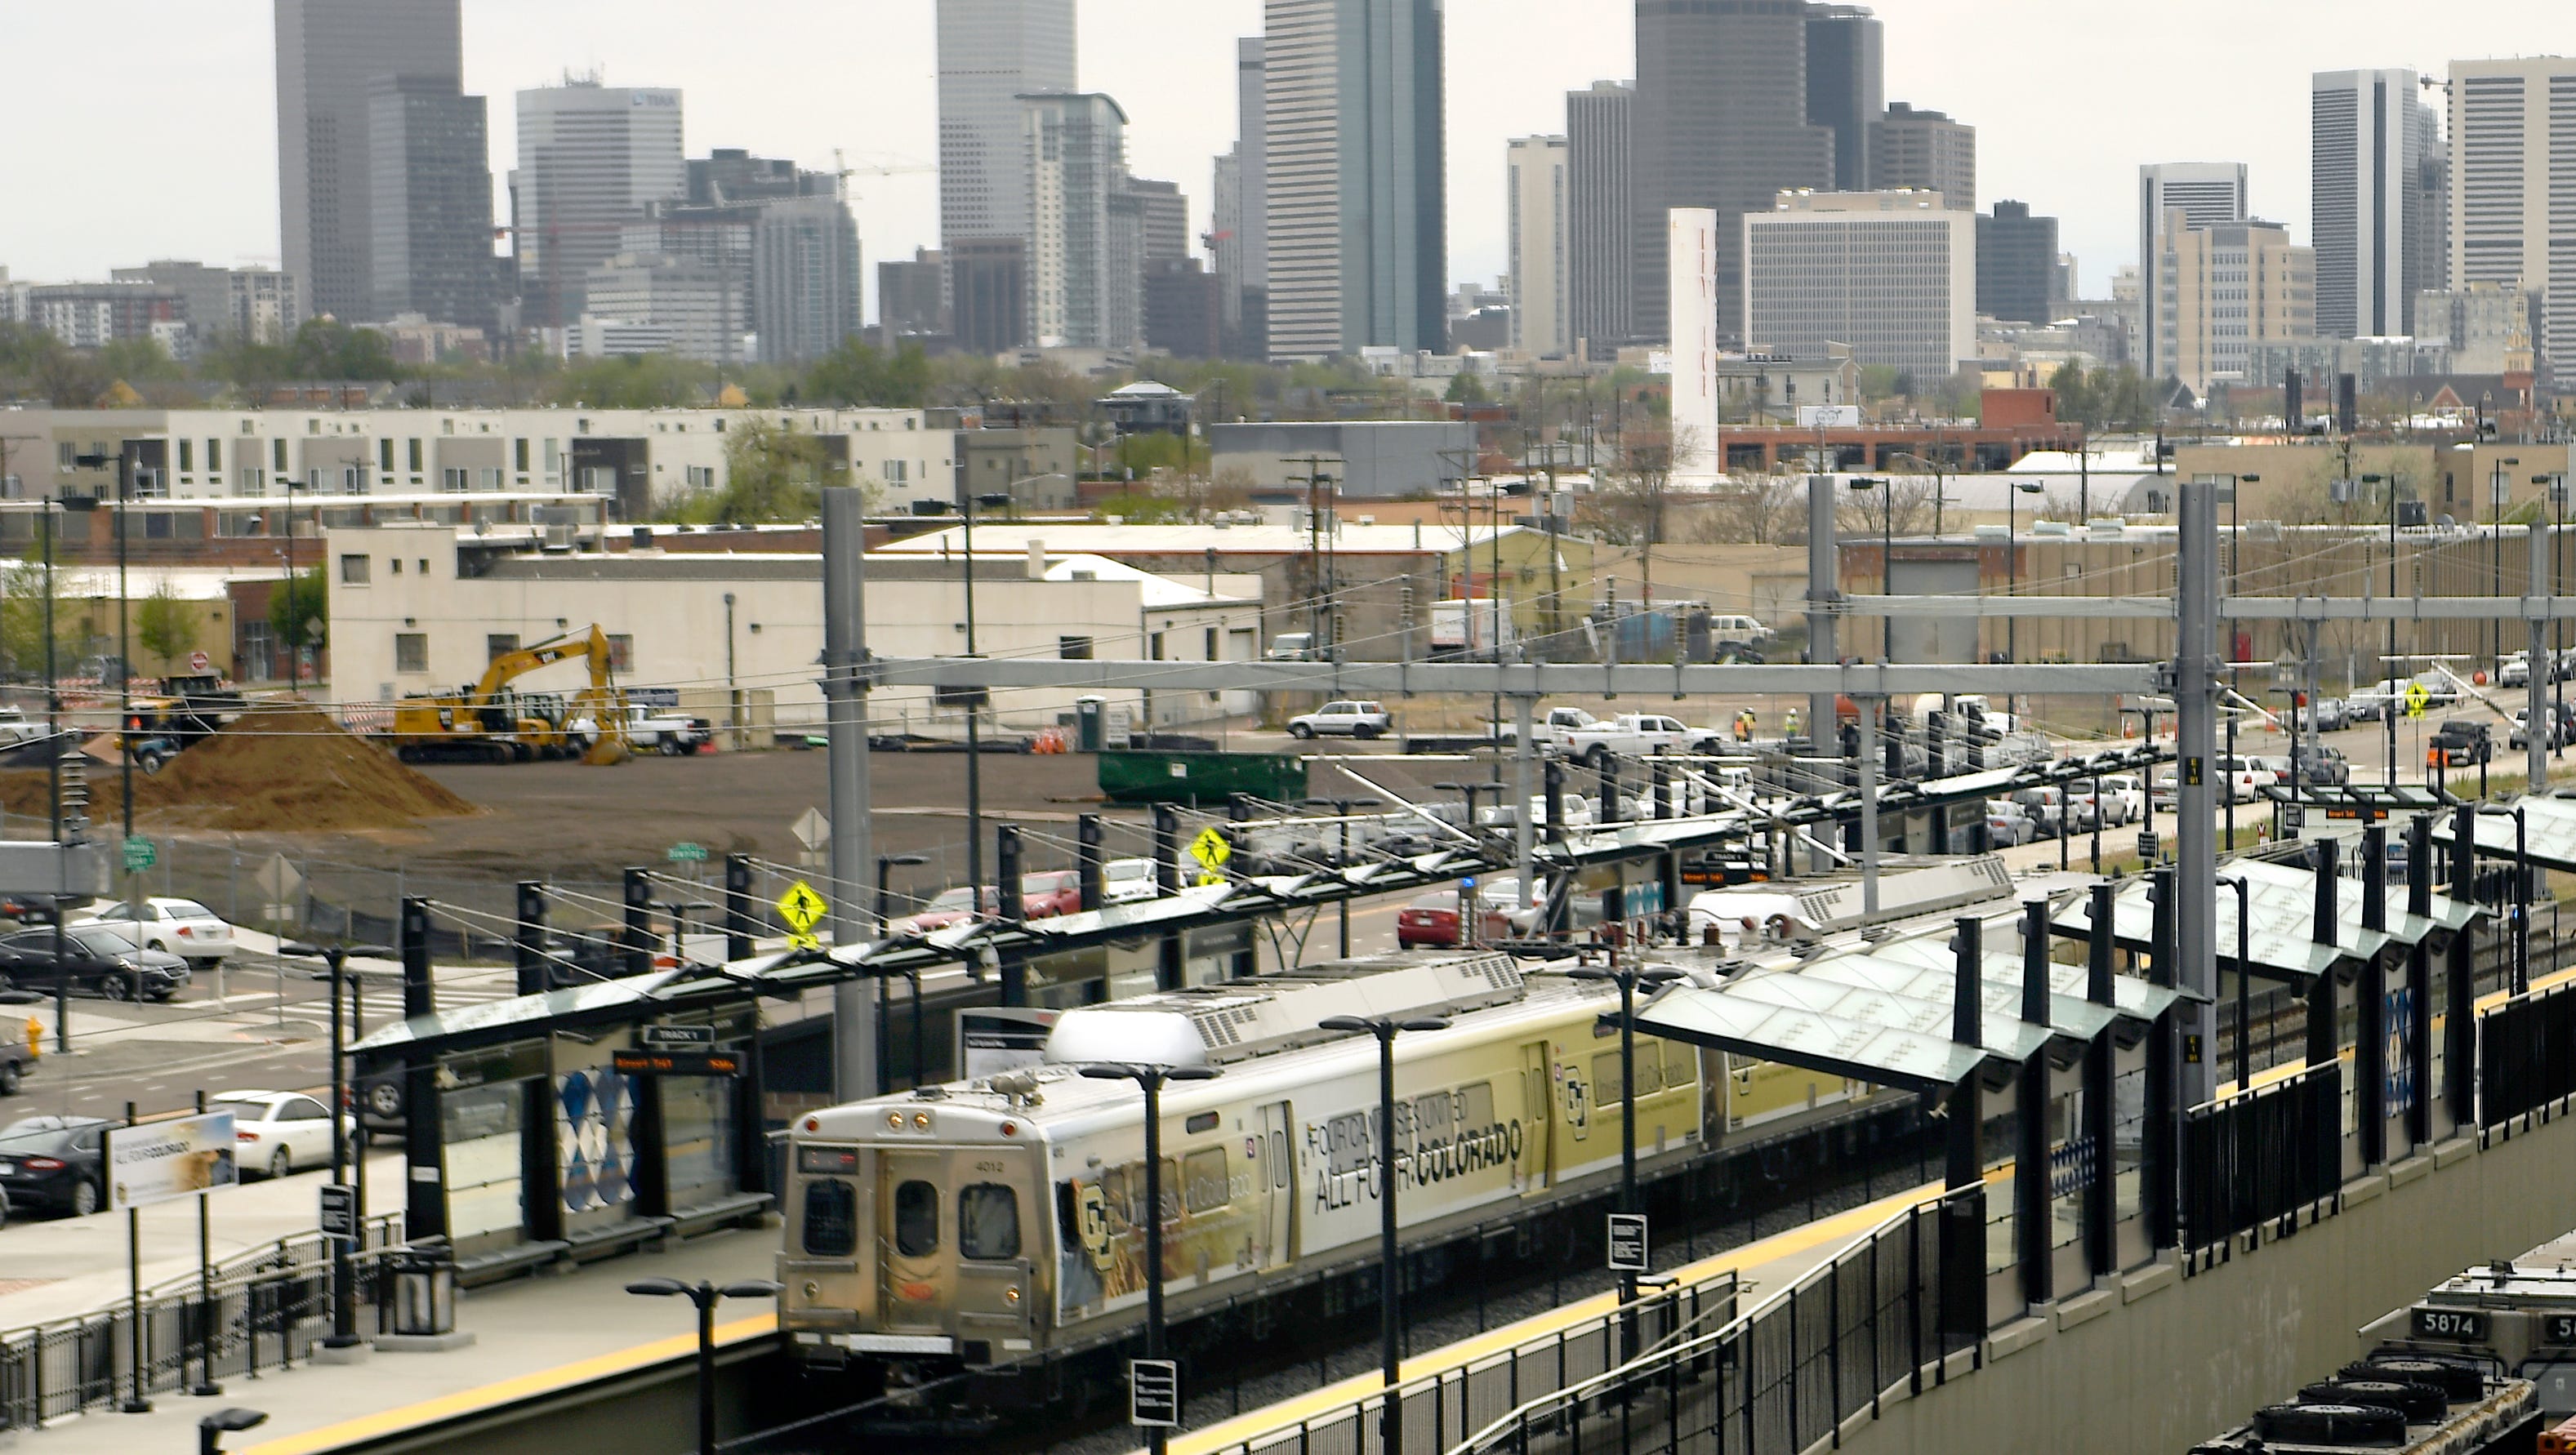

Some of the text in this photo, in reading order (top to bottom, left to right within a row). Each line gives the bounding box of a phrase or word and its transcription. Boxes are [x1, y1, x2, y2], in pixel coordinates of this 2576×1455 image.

[646, 93, 677, 106] TIAA
[659, 1030, 691, 1040] TRACK
[1308, 1118, 1348, 1158] FOUR
[1421, 1092, 1468, 1129] UNITED
[975, 1161, 1005, 1172] 4012
[1314, 1161, 1351, 1215] ALL
[1416, 1117, 1522, 1187] COLORADO
[1196, 1171, 1251, 1208] Colorado
[2424, 1313, 2474, 1334] 5874
